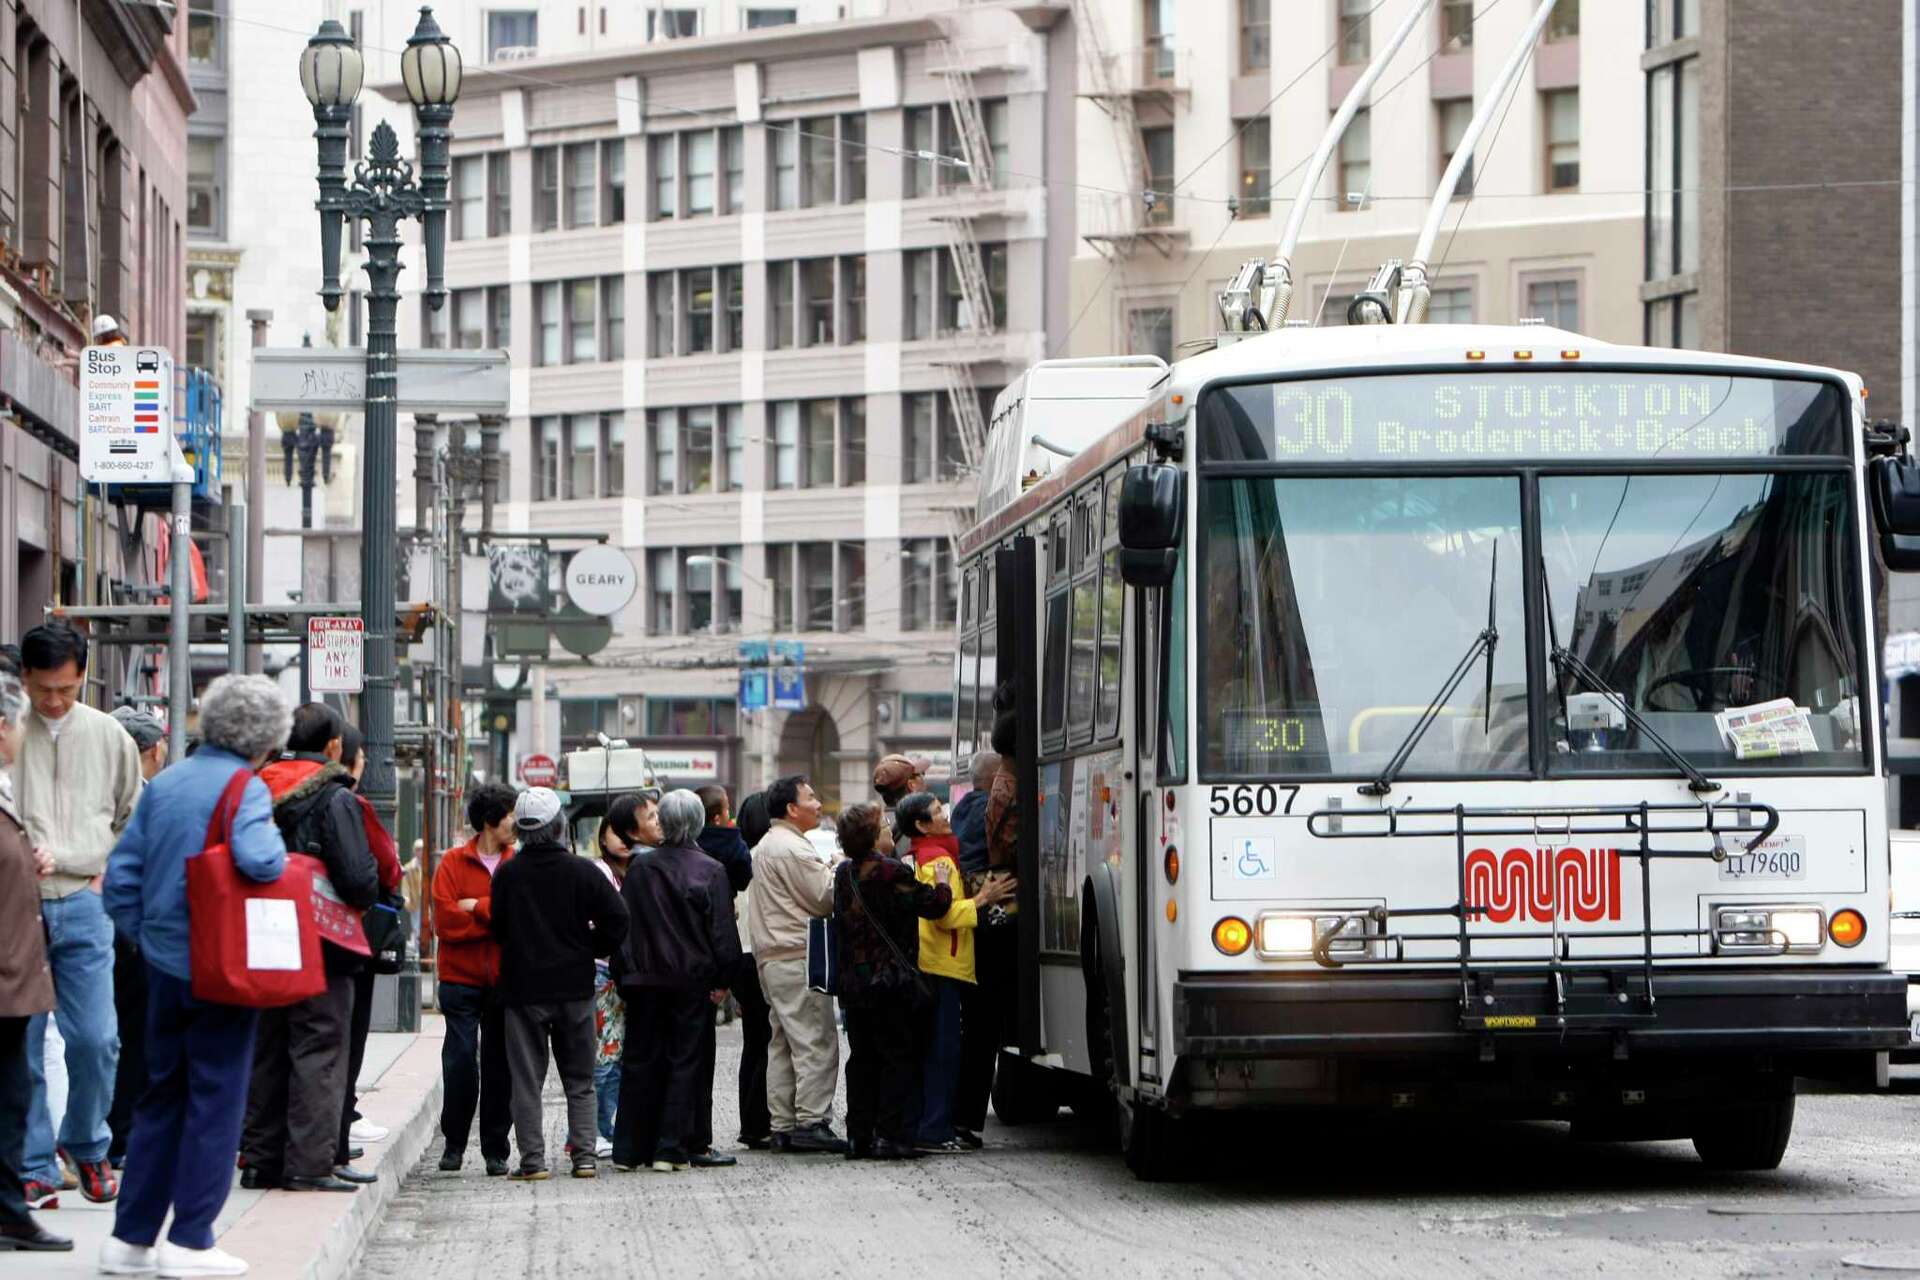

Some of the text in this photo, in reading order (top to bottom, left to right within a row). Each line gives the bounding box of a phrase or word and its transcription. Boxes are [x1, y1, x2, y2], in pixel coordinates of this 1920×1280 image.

[88, 351, 116, 362] Bus
[88, 363, 121, 376] Stop
[88, 381, 131, 391] Community
[88, 392, 122, 402] Express
[88, 403, 113, 412] BART
[88, 414, 121, 423] Caltrain
[1277, 383, 1711, 454] 30 STOCKTON
[93, 461, 155, 470] 1-800-660-4287
[575, 573, 626, 585] GEARY
[311, 631, 325, 648] NO
[325, 651, 348, 664] ANY
[324, 665, 351, 678] TIME
[1255, 719, 1305, 752] 30
[1209, 784, 1301, 816] 5607
[1725, 851, 1800, 874] 1179600
